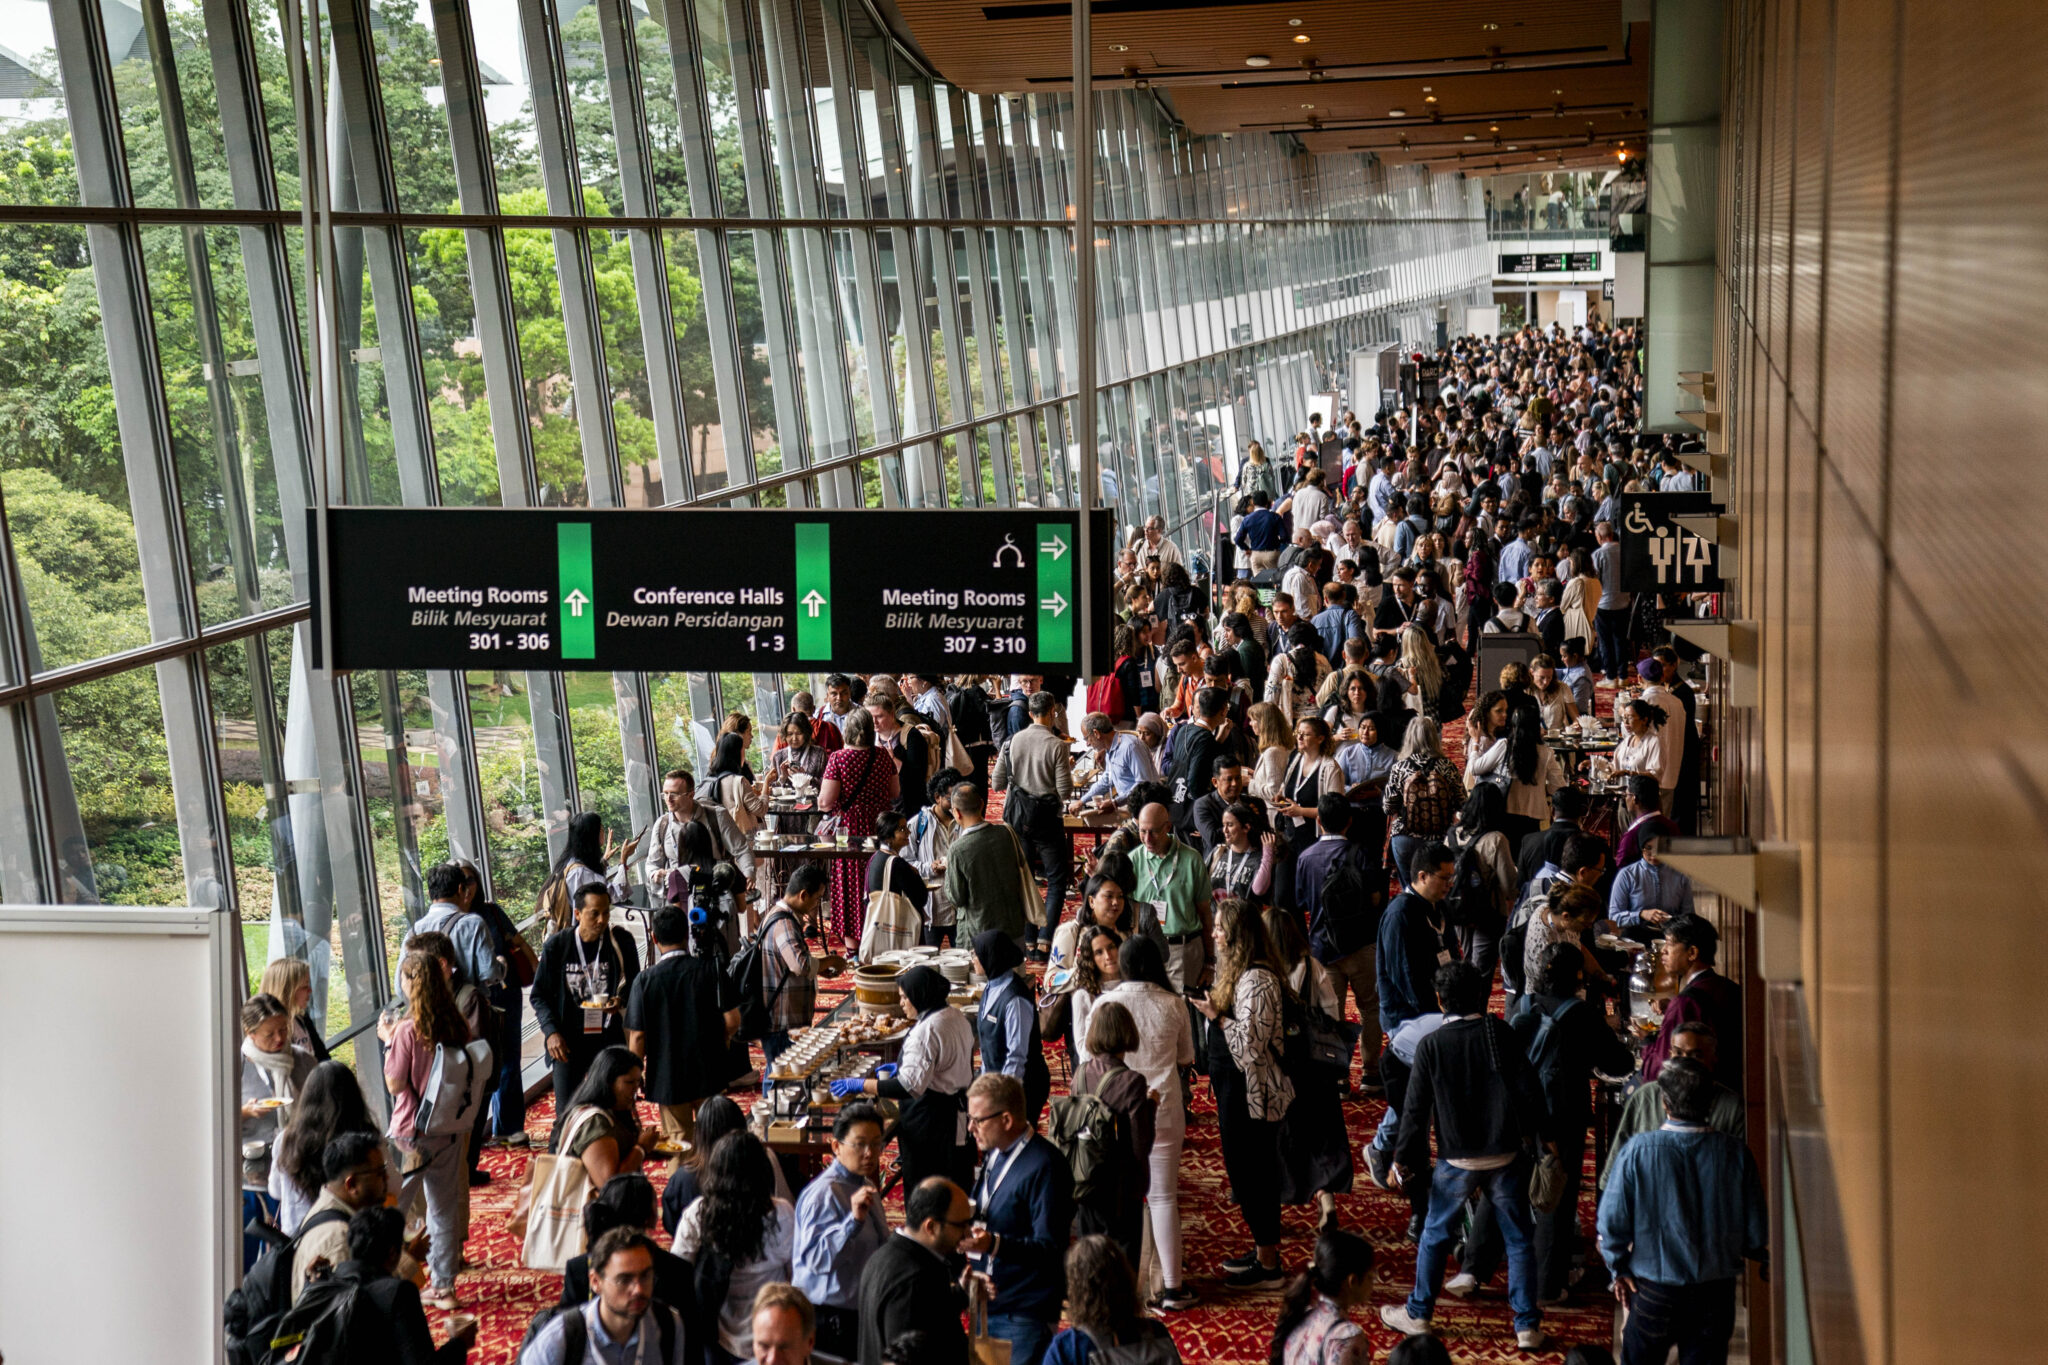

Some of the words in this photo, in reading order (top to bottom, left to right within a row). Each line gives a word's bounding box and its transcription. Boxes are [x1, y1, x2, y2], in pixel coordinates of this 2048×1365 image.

[408, 586, 484, 608] Meeting
[487, 586, 549, 604] Rooms
[633, 586, 736, 605] Conference
[739, 586, 785, 605] Halls
[882, 588, 959, 610] Meeting
[963, 589, 1026, 607] Rooms
[411, 609, 449, 626] Bilik
[453, 610, 548, 630] Mesyuarat
[605, 611, 669, 628] Dewan
[674, 611, 784, 632] Persidangan
[885, 612, 924, 629] Bilik
[928, 613, 1024, 633] Mesyuarat
[469, 632, 501, 650] 301
[517, 632, 551, 651] 306
[943, 636, 977, 654] 307
[992, 636, 1027, 654] 310
